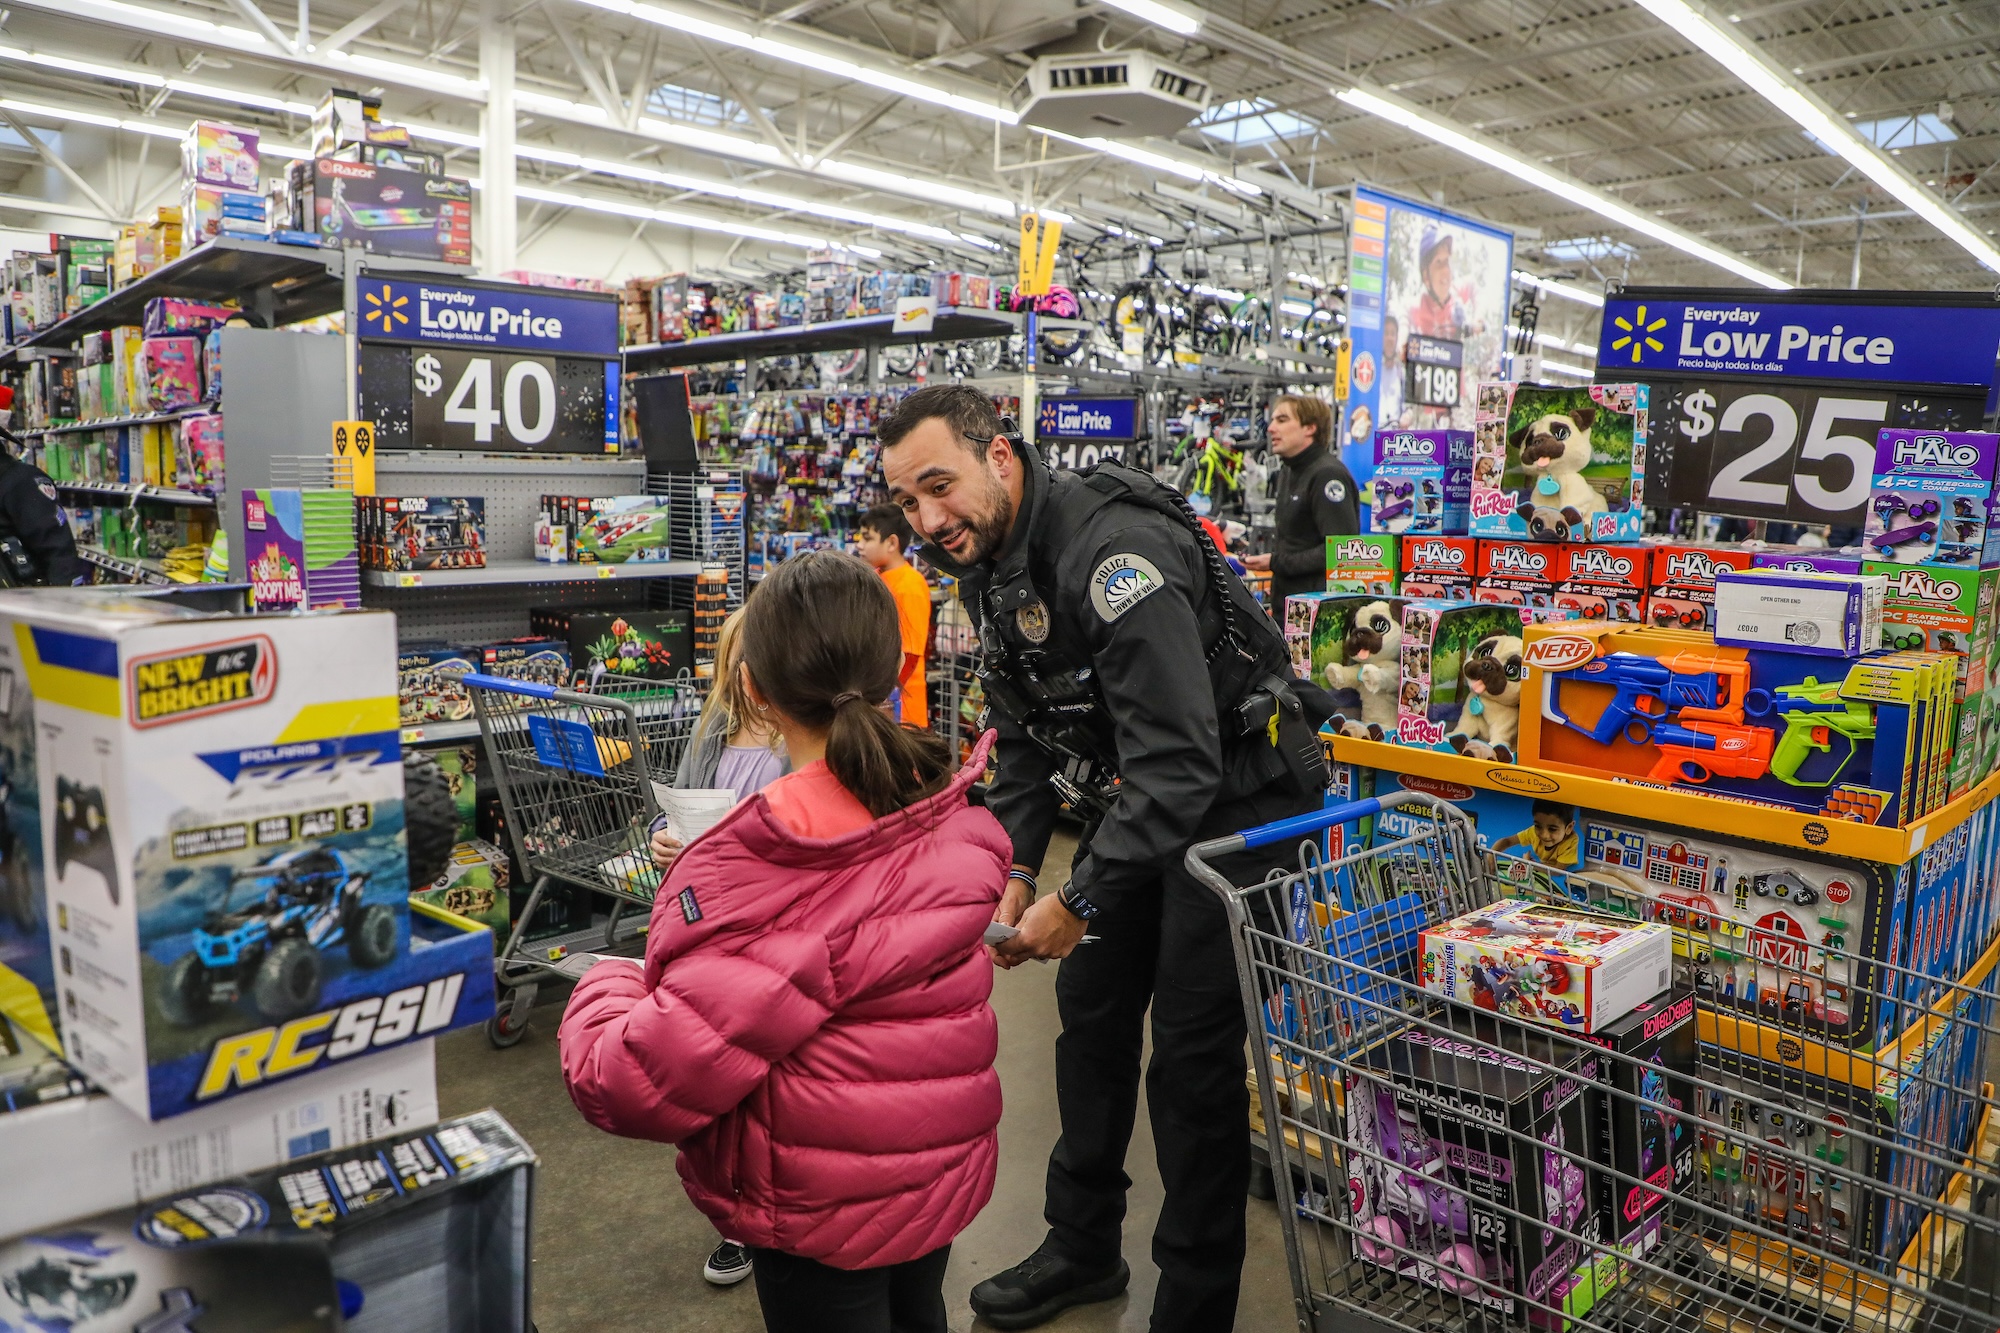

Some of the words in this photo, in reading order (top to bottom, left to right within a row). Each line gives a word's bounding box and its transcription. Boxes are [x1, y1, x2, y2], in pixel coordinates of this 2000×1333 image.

[331, 163, 376, 179] Razor
[420, 288, 475, 306] Everyday
[420, 301, 485, 333] Low
[490, 306, 562, 338] Price
[1684, 306, 1760, 327] Everyday
[420, 330, 440, 338] Precio
[441, 331, 454, 341] bajo
[455, 332, 472, 341] todos
[473, 333, 482, 341] los
[1679, 322, 1780, 359] Low
[1787, 326, 1894, 365] Price
[1678, 358, 1707, 369] Precio
[1709, 360, 1726, 372] bajo
[1728, 361, 1751, 371] todos
[1753, 362, 1765, 371] los
[1767, 362, 1784, 373] días
[1415, 364, 1458, 404] $198
[414, 353, 557, 445] $40
[1058, 411, 1081, 429] Low
[1082, 410, 1111, 430] Price
[1384, 433, 1436, 456] HALO
[1680, 388, 1888, 511] $25
[1894, 436, 1978, 466] HALO
[1375, 466, 1386, 476] 4
[1876, 475, 1894, 488] 4
[1896, 479, 1919, 488] PC
[1922, 480, 1985, 489] SKATEBOARD
[399, 503, 429, 512] WARS
[402, 497, 428, 505] STAR
[1471, 492, 1518, 517] furReal
[1336, 540, 1383, 561] HALO
[1414, 541, 1465, 564] HALO
[1491, 546, 1547, 571] HALO
[1095, 558, 1129, 585] POLICE
[1571, 550, 1632, 575] HALO
[1668, 553, 1734, 578] HALO
[1329, 570, 1339, 579] 4
[1339, 571, 1352, 579] PC
[1404, 572, 1414, 582] 4
[1414, 574, 1430, 582] PC
[1480, 577, 1491, 588] 4
[1492, 579, 1508, 588] PC
[1510, 580, 1552, 589] SKATEBOARD
[254, 582, 284, 602] ADOPT
[285, 582, 302, 600] ME!
[1559, 582, 1572, 593] 4
[1573, 584, 1590, 594] PC
[1592, 586, 1638, 595] SKATEBOARD
[1654, 587, 1669, 598] 4
[1669, 589, 1687, 599] PC
[1689, 591, 1715, 599] SKATE
[1882, 571, 1961, 601] HALO
[1112, 600, 1134, 615] TOWN
[1133, 591, 1143, 601] OF
[1143, 582, 1157, 595] VAIL
[1906, 613, 1968, 623] SKATEBOARD
[1906, 618, 1940, 626] COMBO
[1525, 640, 1593, 661] NERF
[137, 655, 204, 690] NEW
[216, 650, 246, 672] R/C
[1584, 663, 1606, 672] NERF
[138, 671, 252, 719] BRIGHT
[1400, 718, 1444, 746] furReal
[239, 742, 321, 764] POLARIS
[1722, 739, 1747, 749] NERF
[1405, 774, 1438, 790] Melissa
[1446, 785, 1467, 798] Doug
[1494, 770, 1525, 786] Melissa
[1525, 777, 1532, 785] &
[1533, 779, 1554, 792] Doug
[1804, 830, 1828, 838] SUPPLIES
[1828, 886, 1848, 897] STOP
[1426, 951, 1435, 983] MARIO
[1444, 944, 1456, 971] TOWER
[1443, 971, 1456, 998] SHAKY
[1453, 1148, 1499, 1167] ADUSTABLE
[1675, 1152, 1692, 1185] 3-6
[1473, 1213, 1506, 1244] 12-2
